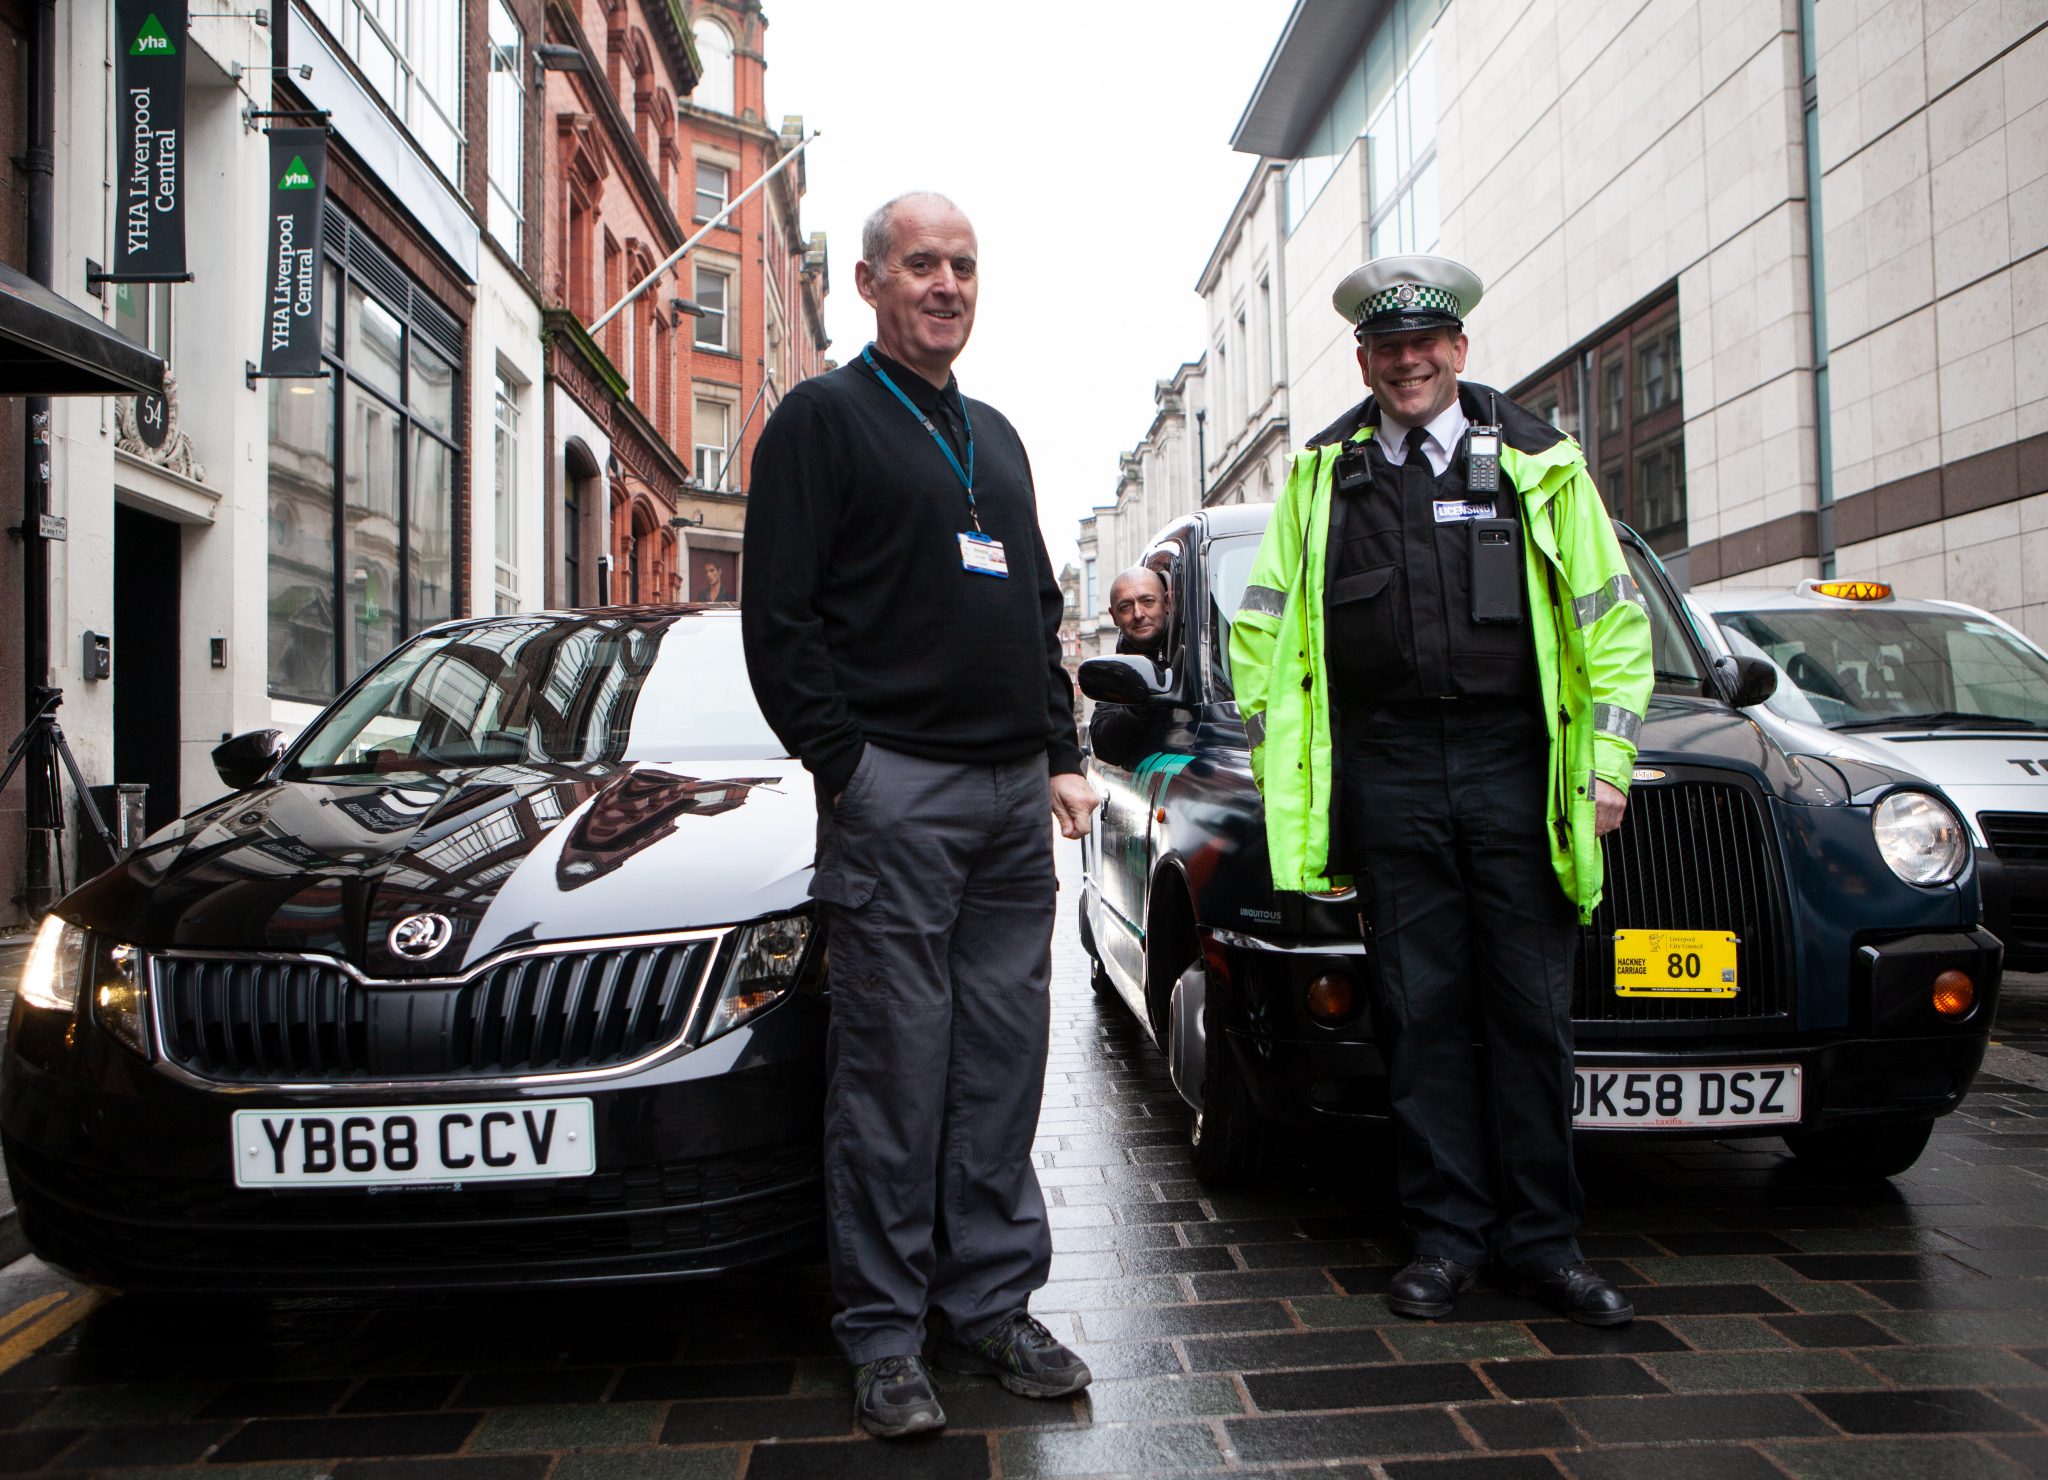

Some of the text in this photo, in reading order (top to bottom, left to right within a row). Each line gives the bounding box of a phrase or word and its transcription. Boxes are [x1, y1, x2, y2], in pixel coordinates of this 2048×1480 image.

[138, 34, 167, 50] yha
[128, 87, 153, 255] YHA Liverpool
[155, 128, 175, 213] Central
[285, 172, 309, 186] yha
[272, 214, 295, 351] YHA Liverpool
[295, 248, 314, 317] Central
[144, 395, 162, 429] 54
[1438, 504, 1490, 515] LICENSING
[1834, 584, 1880, 600] TAXI
[1617, 958, 1646, 966] HACKNEY
[1617, 966, 1647, 975] CARRIAGE
[1667, 953, 1700, 978] 80
[1698, 1070, 1785, 1116] DSZ
[261, 1108, 558, 1174] YB68 CCV
